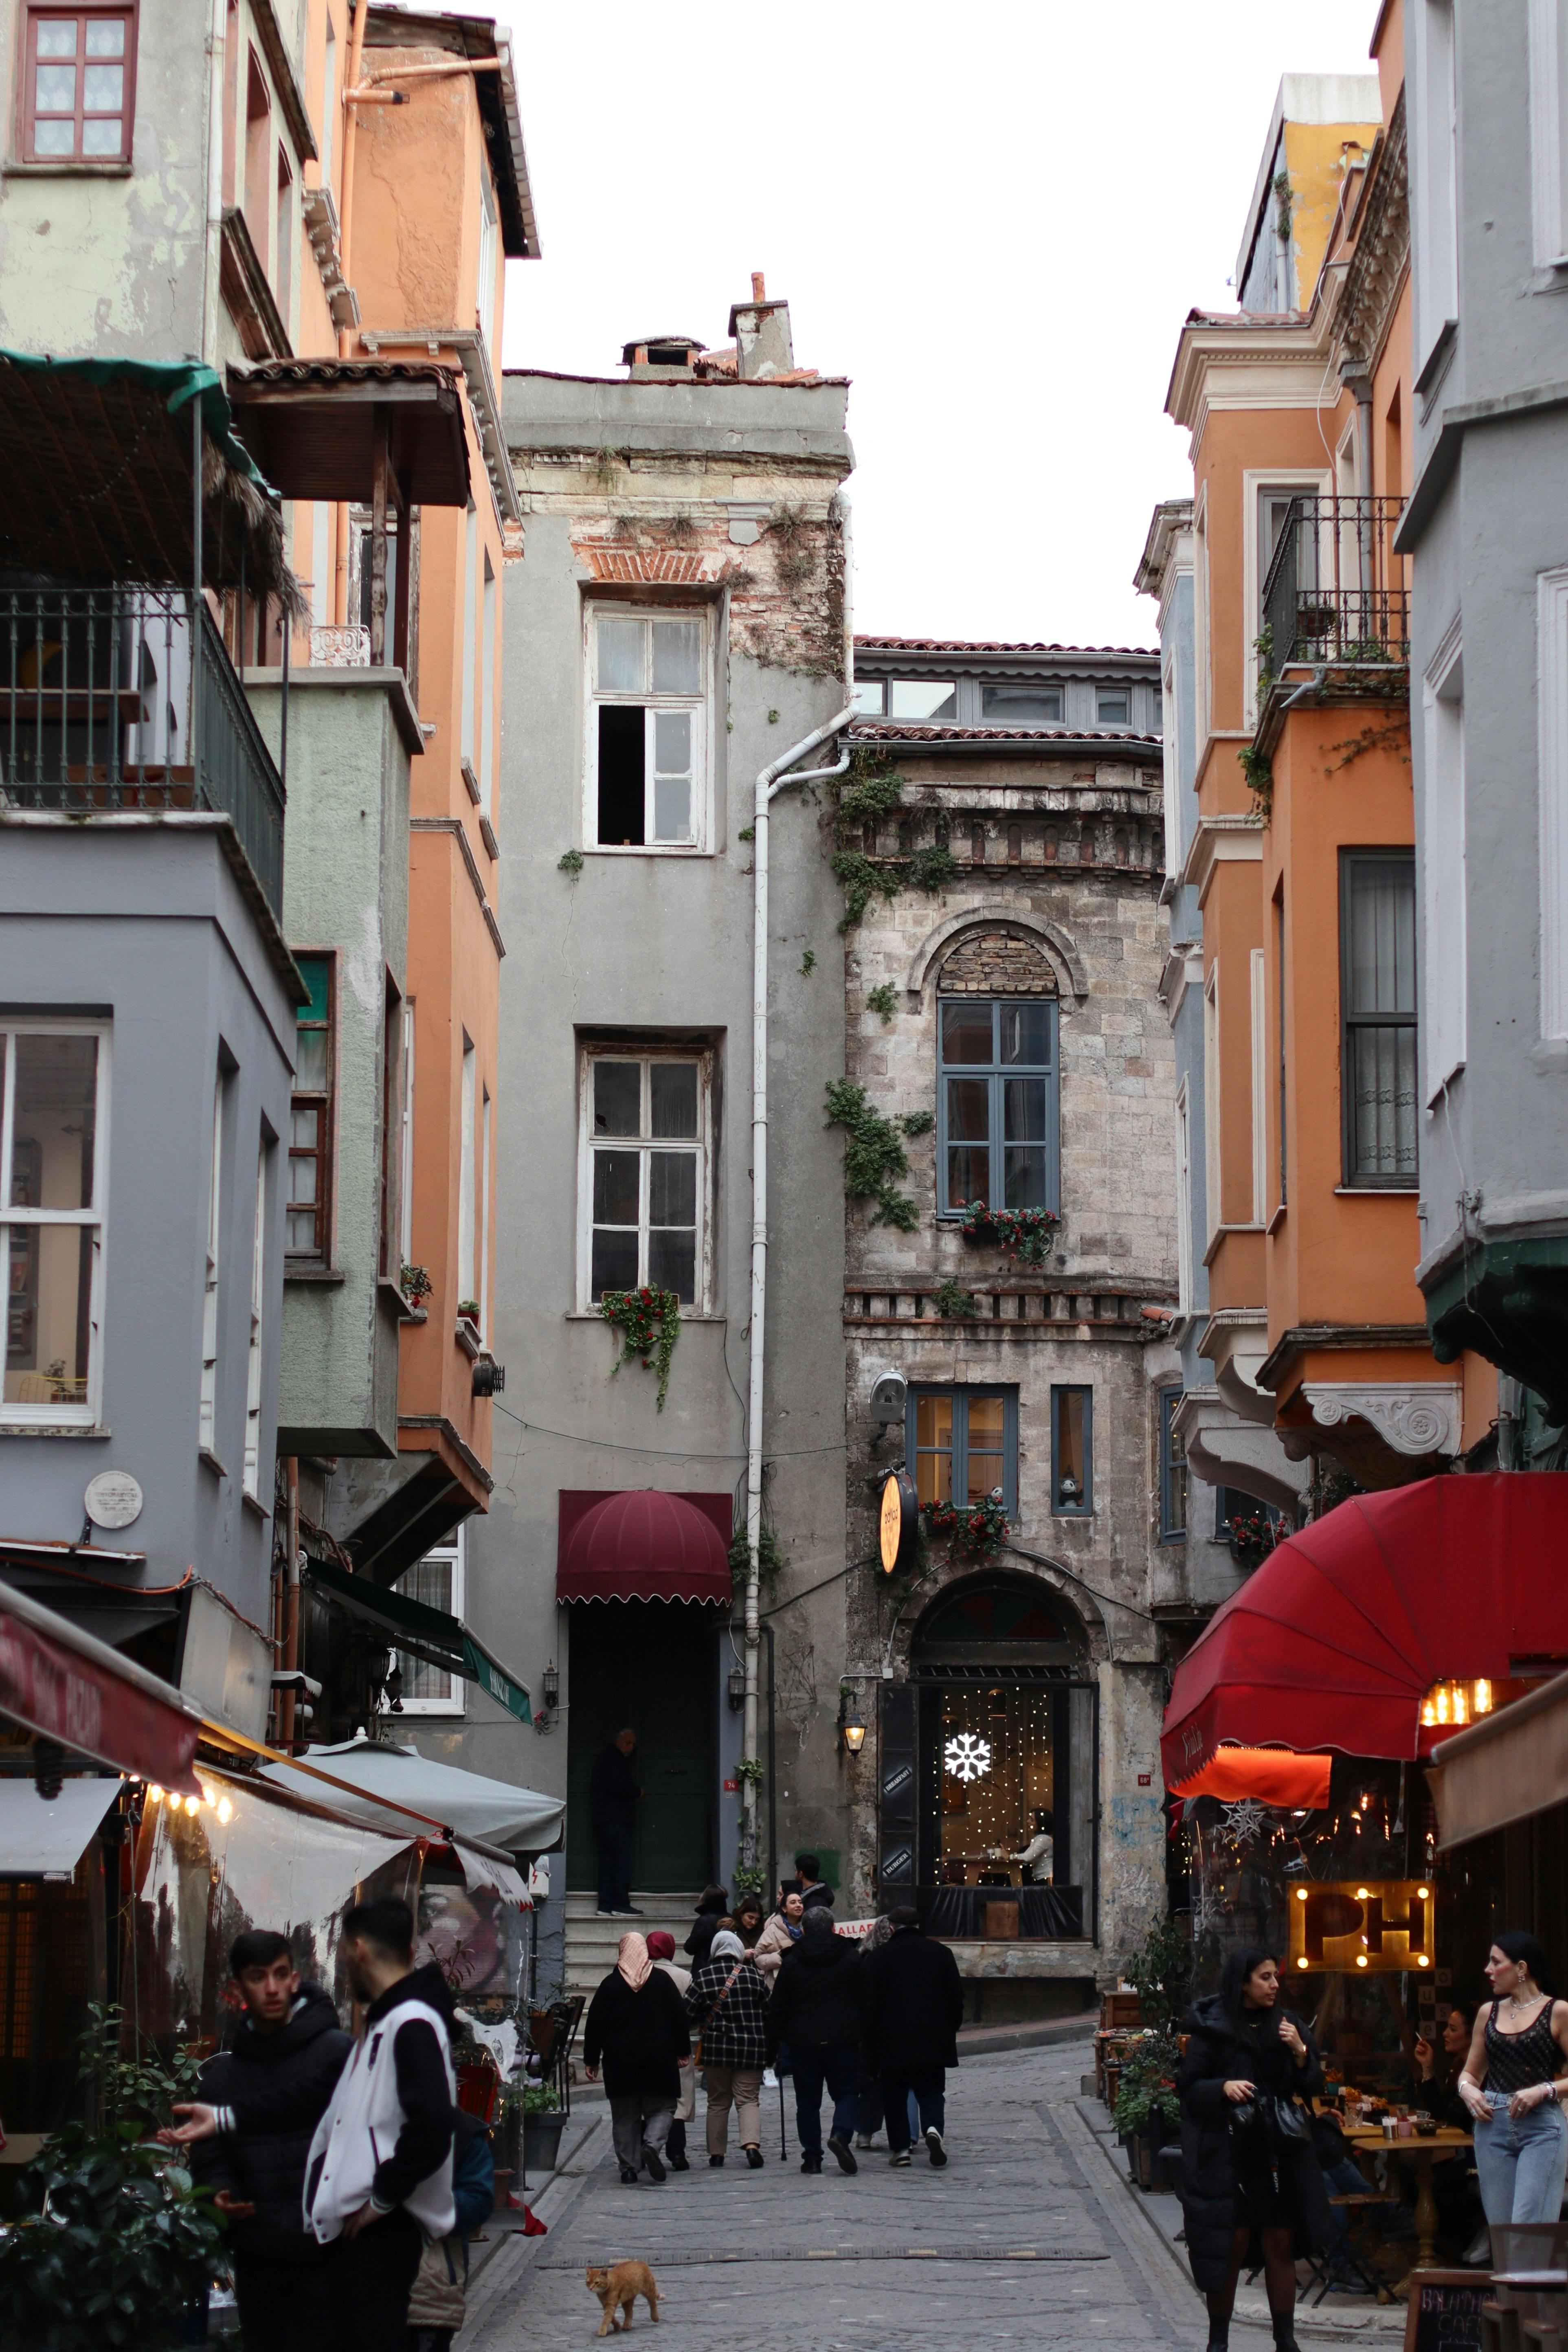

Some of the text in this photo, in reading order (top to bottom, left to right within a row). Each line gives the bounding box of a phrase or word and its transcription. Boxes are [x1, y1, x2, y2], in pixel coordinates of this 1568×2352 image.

[885, 1505, 898, 1524] ballad
[885, 1769, 909, 1791] BREAKFAST
[886, 1853, 909, 1873] BURGER
